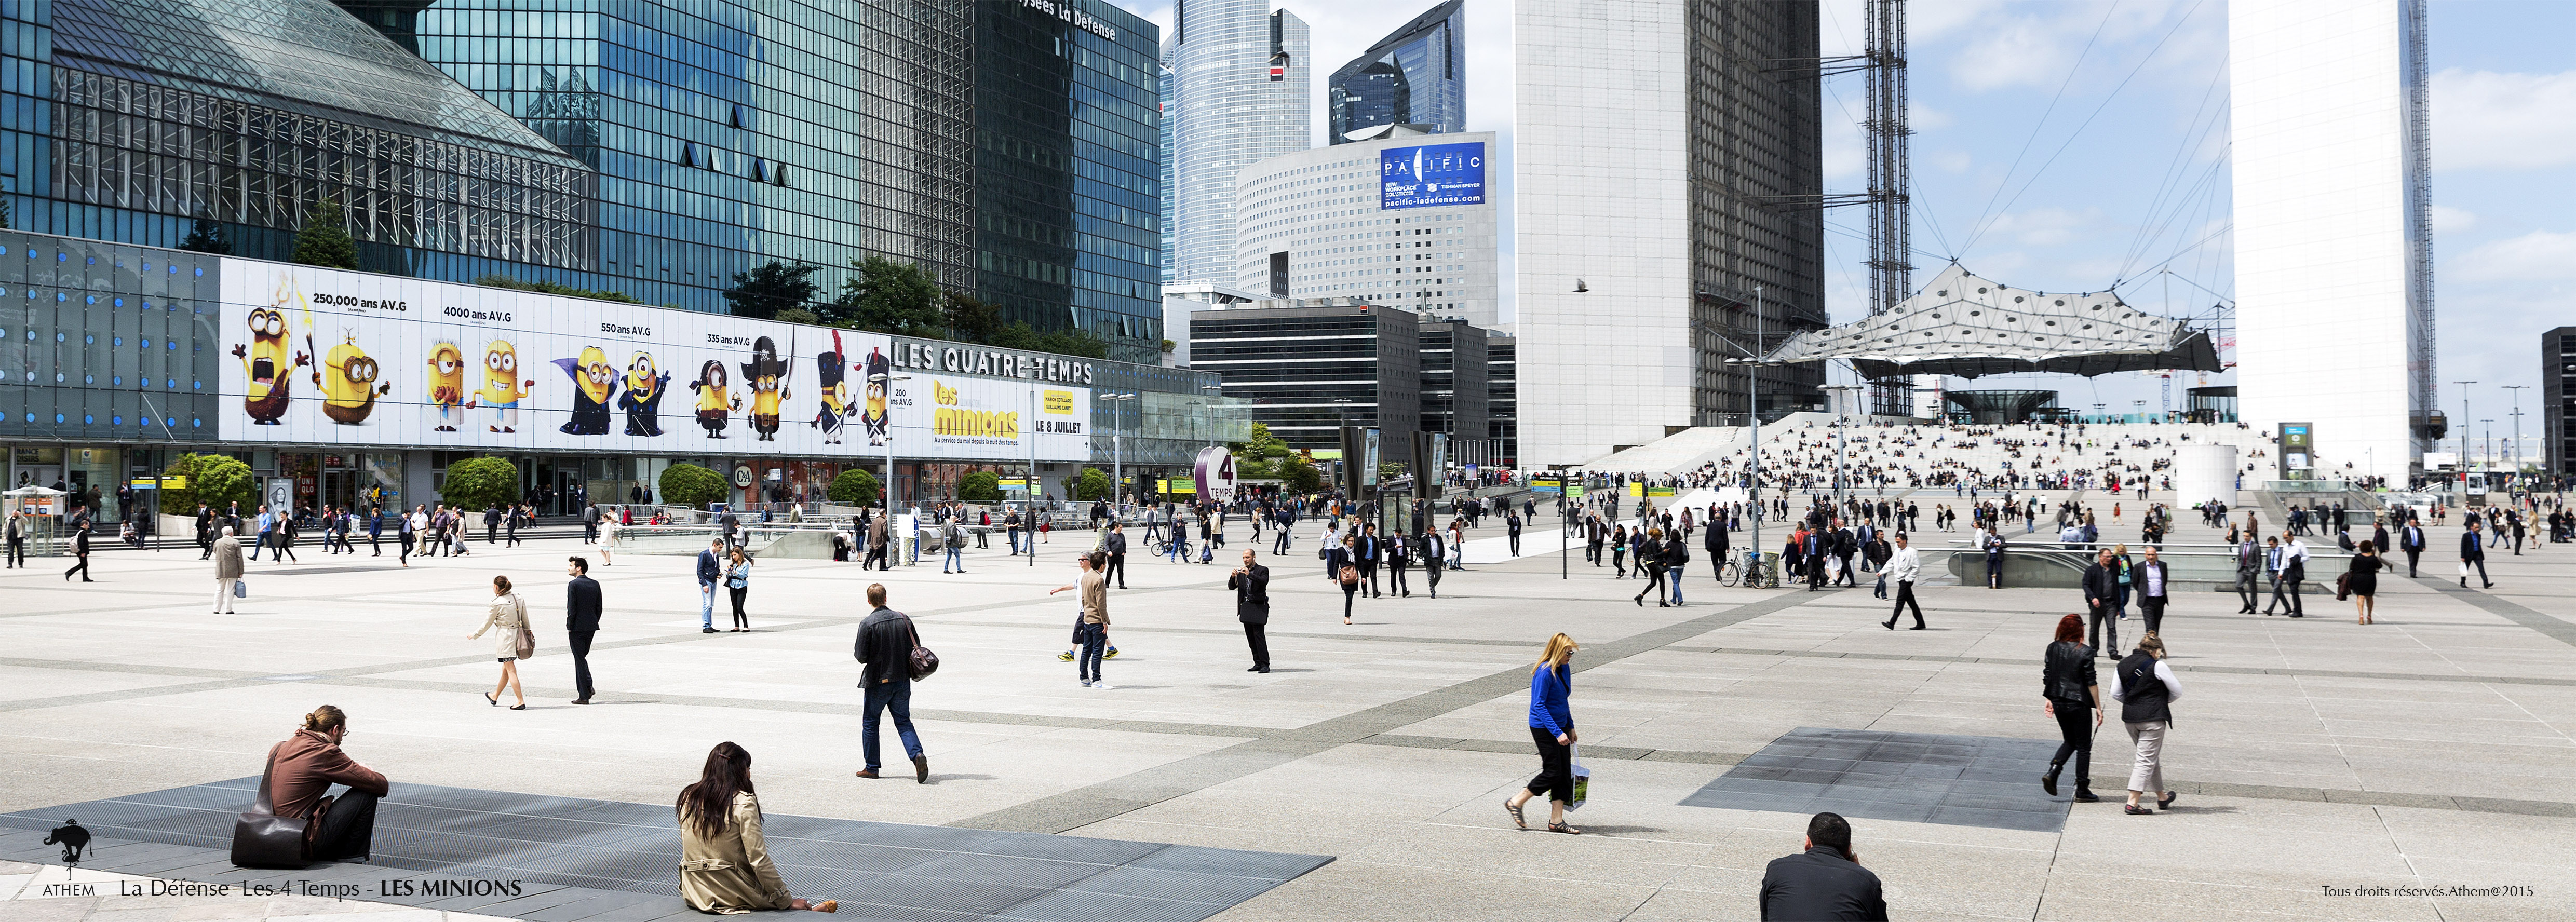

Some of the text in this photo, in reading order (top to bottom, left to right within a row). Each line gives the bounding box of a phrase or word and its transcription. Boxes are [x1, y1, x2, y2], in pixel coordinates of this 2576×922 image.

[1059, 3, 1070, 22] La
[1075, 10, 1115, 40] Défense
[1385, 195, 1480, 207] pacific-ladefense.com
[314, 293, 406, 311] 250,000 ans AV.G
[444, 306, 511, 322] 4000 ans AV.G
[601, 323, 616, 332] 550
[632, 326, 650, 336] AV.G
[707, 334, 719, 343] 335
[734, 336, 750, 346] AV.G
[894, 341, 1092, 384] LES QUATRE TEMPS
[934, 380, 957, 406] les
[934, 407, 1019, 439] minions
[1036, 420, 1081, 433] LE 8 JUILLET
[737, 470, 751, 482] C&A
[1218, 455, 1233, 485] 4
[1211, 487, 1232, 497] TEMPS
